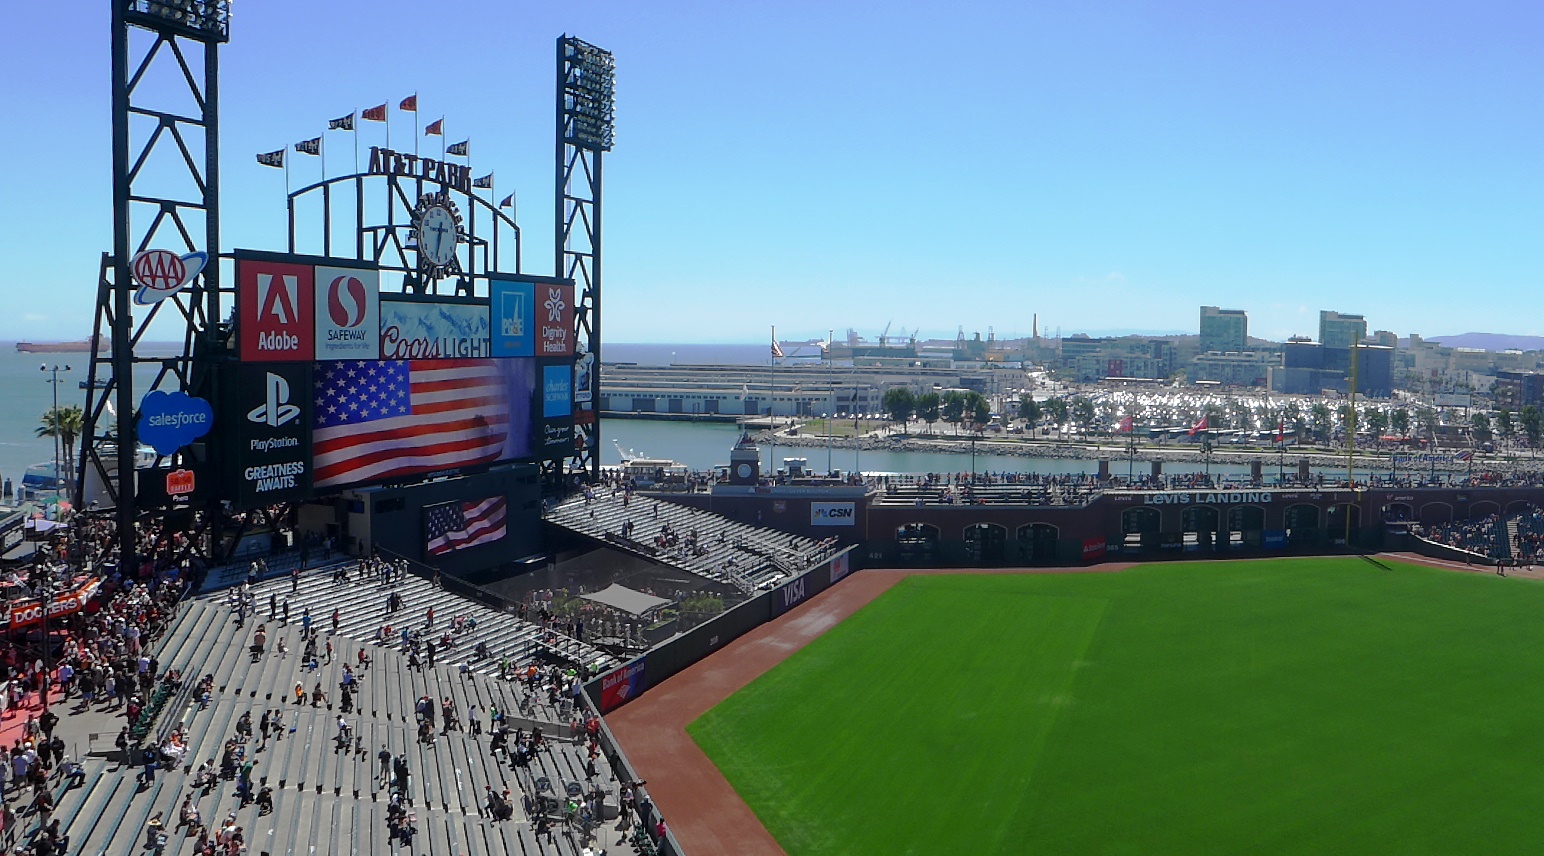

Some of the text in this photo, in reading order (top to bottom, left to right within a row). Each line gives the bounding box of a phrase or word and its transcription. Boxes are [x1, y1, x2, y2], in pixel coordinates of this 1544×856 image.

[368, 146, 418, 176] AT&T
[421, 157, 471, 196] PARK
[141, 252, 182, 289] AAA
[258, 326, 298, 355] Adobe
[328, 329, 366, 341] SAFEWAY
[542, 326, 567, 341] Dignity
[380, 326, 489, 359] Coors LIGHT
[543, 340, 567, 353] Health
[149, 411, 206, 429] salesforce
[250, 437, 298, 452] PlayStation
[244, 461, 304, 481] GREATNESS
[1195, 492, 1273, 503] LANDING
[828, 508, 853, 518] CSN
[868, 552, 883, 560] 421
[782, 577, 806, 607] VISA
[603, 673, 617, 690] Bank
